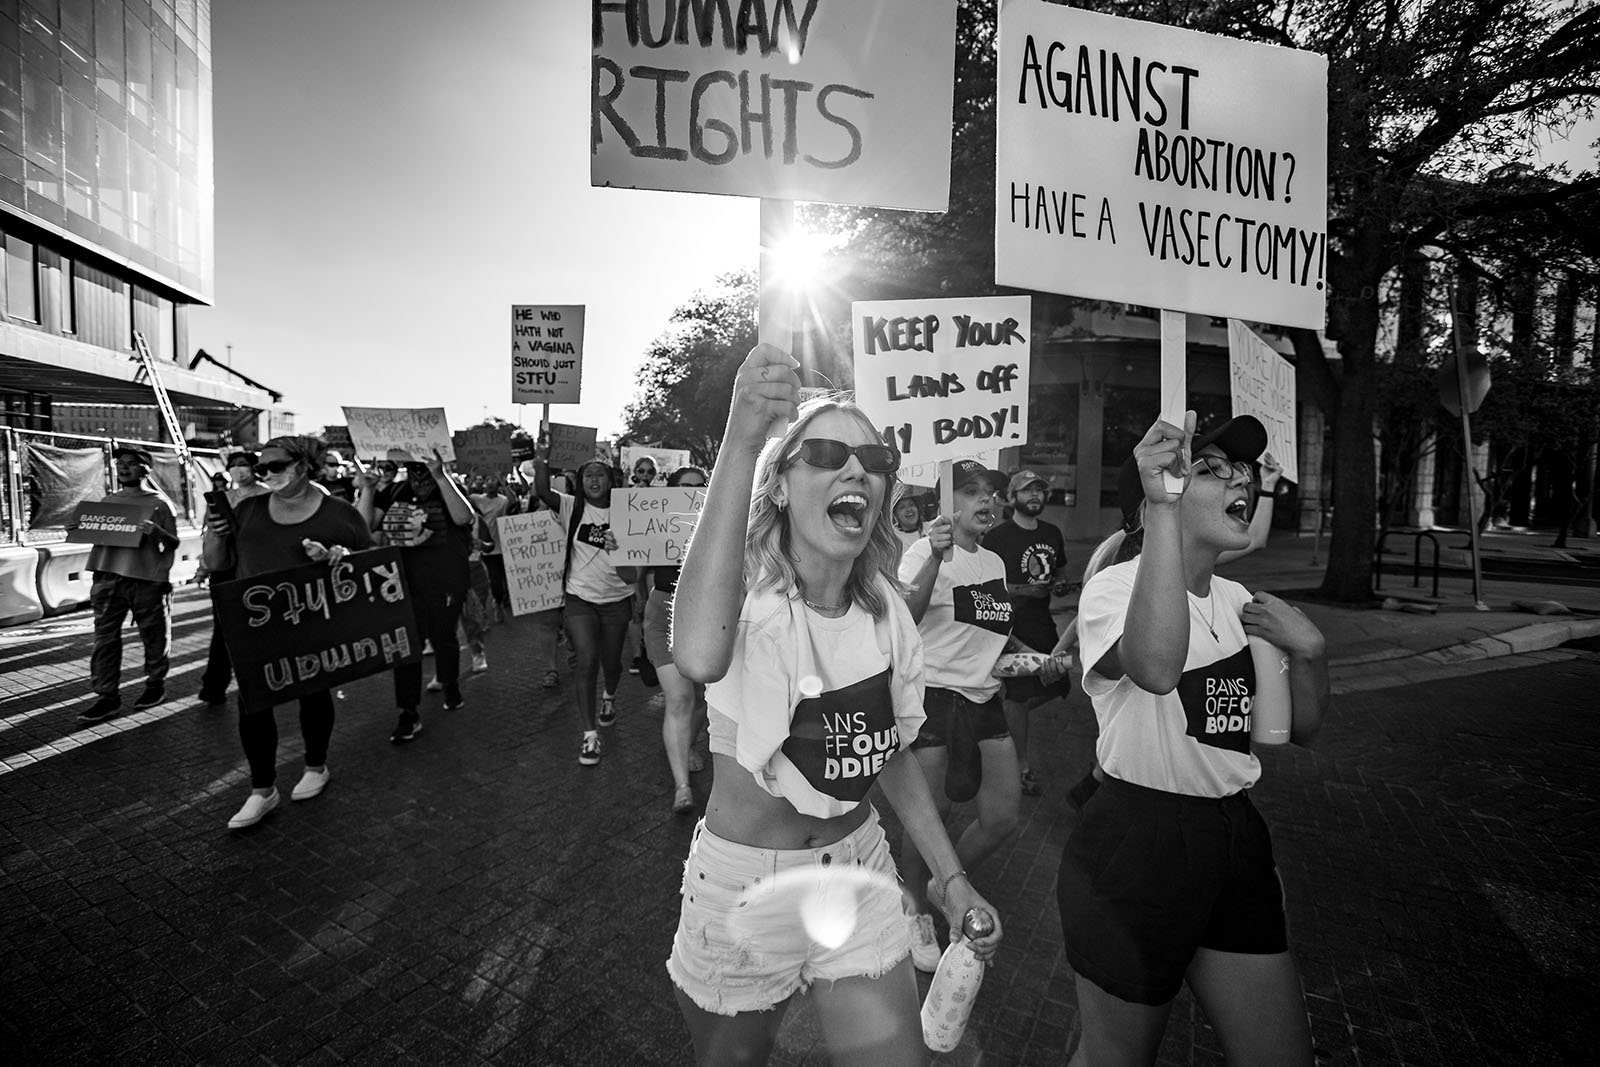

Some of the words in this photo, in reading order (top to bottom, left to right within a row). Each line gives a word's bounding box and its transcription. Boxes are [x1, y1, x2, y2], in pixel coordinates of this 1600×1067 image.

[592, 0, 817, 57] HUMAN
[1018, 34, 1200, 131] AGAINST
[591, 54, 875, 169] RIGHTS
[1134, 127, 1296, 204] ABORTION?
[1011, 181, 1087, 239] HAVE
[1097, 197, 1117, 245] A
[1138, 201, 1327, 291] VASECTOMY!
[515, 308, 533, 321] HE
[514, 324, 542, 337] HATH
[547, 327, 564, 338] NOT
[863, 313, 940, 356] KEEP
[952, 314, 1026, 348] YOUR
[513, 340, 520, 351] A
[528, 340, 575, 354] VAGINA
[514, 356, 550, 368] SHOULD
[553, 360, 576, 370] JUST
[886, 372, 966, 401] LAWS
[932, 404, 1020, 445] BODY!
[627, 492, 669, 513] Keep
[79, 522, 100, 530] OUR
[100, 523, 138, 533] BODIES
[80, 514, 106, 523] BANS
[106, 515, 127, 524] OFF
[627, 516, 681, 537] LAWS
[531, 529, 548, 545] not
[510, 545, 537, 561] PRO
[627, 548, 651, 564] my
[537, 562, 554, 570] are
[517, 574, 543, 590] PRO
[970, 590, 995, 603] BANS
[974, 599, 992, 610] OFF
[992, 602, 1013, 612] OUR
[975, 609, 1011, 622] BODIES
[264, 626, 411, 692] Human
[1206, 677, 1249, 696] BANS
[1205, 696, 1238, 716] OFF
[822, 711, 868, 733] ANS
[1205, 714, 1251, 734] BODI
[825, 734, 849, 756] FF
[852, 724, 899, 756] OUR
